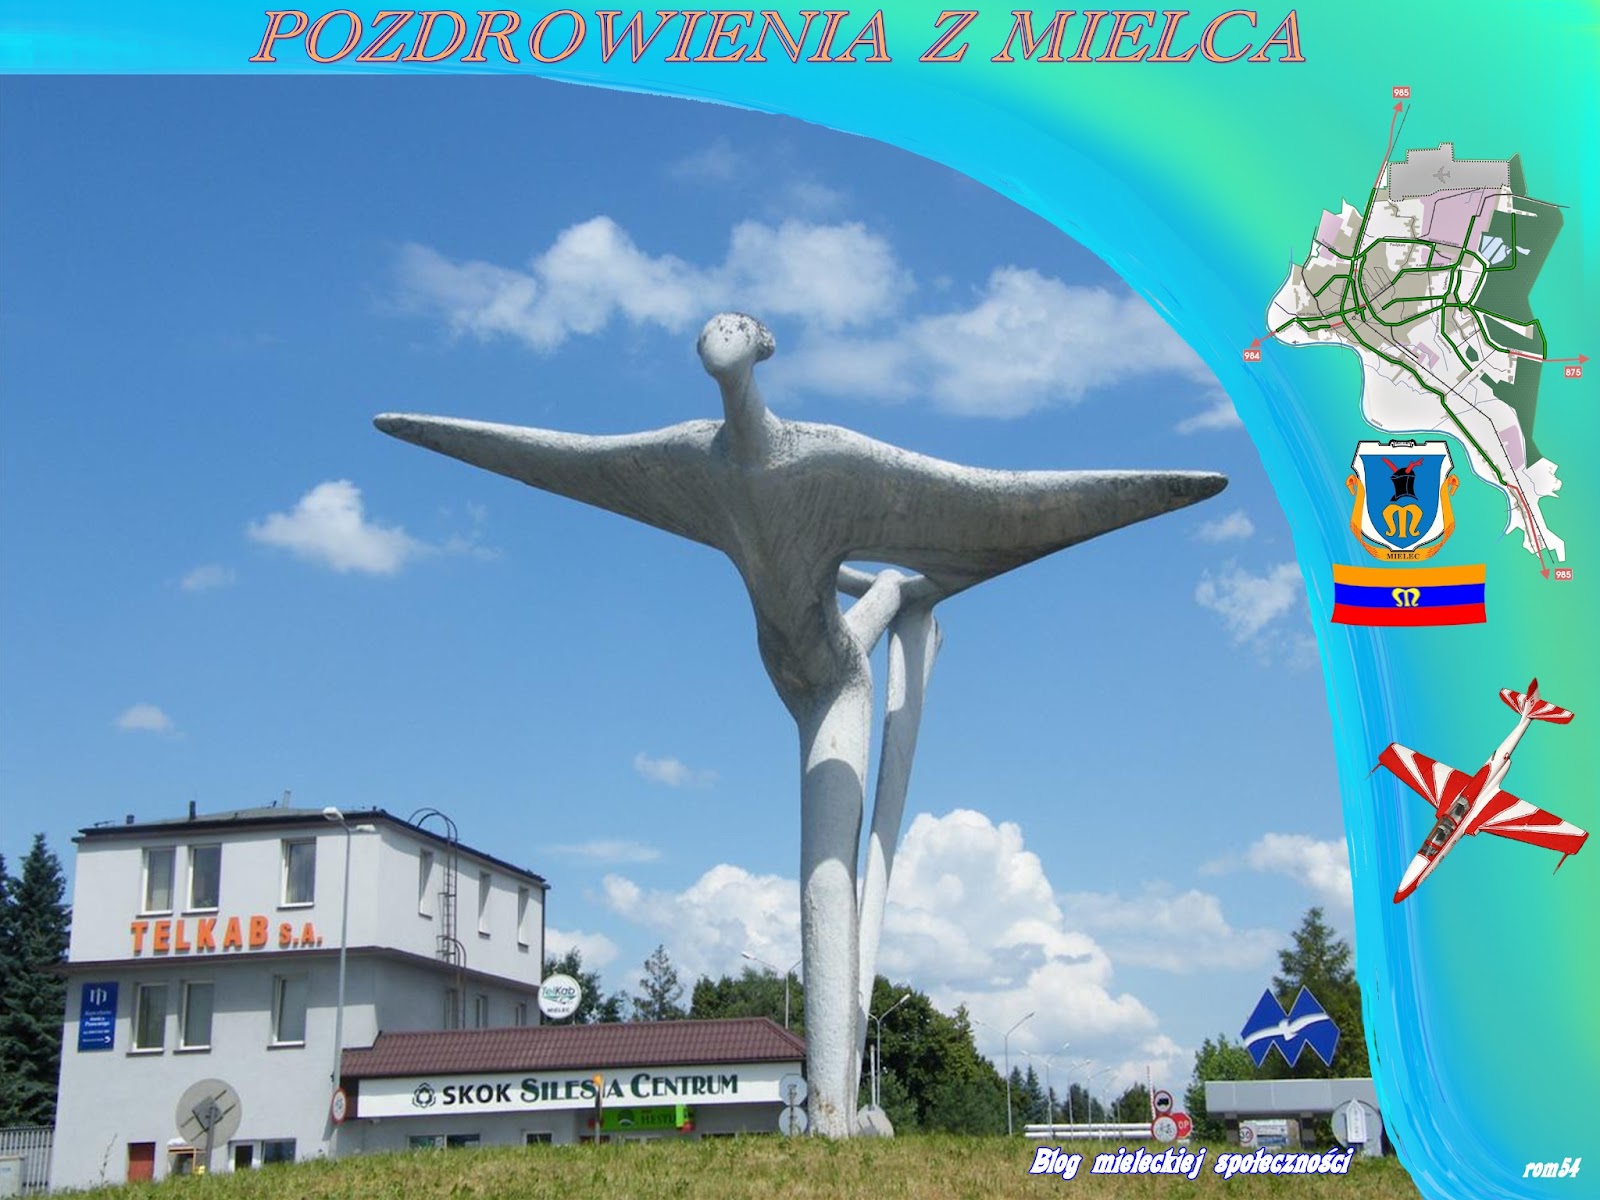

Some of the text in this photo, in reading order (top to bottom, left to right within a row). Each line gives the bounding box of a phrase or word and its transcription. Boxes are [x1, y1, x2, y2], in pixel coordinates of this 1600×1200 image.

[131, 915, 269, 954] TELKAB
[442, 1082, 512, 1106] SKOK
[630, 1073, 739, 1098] CENTRUM
